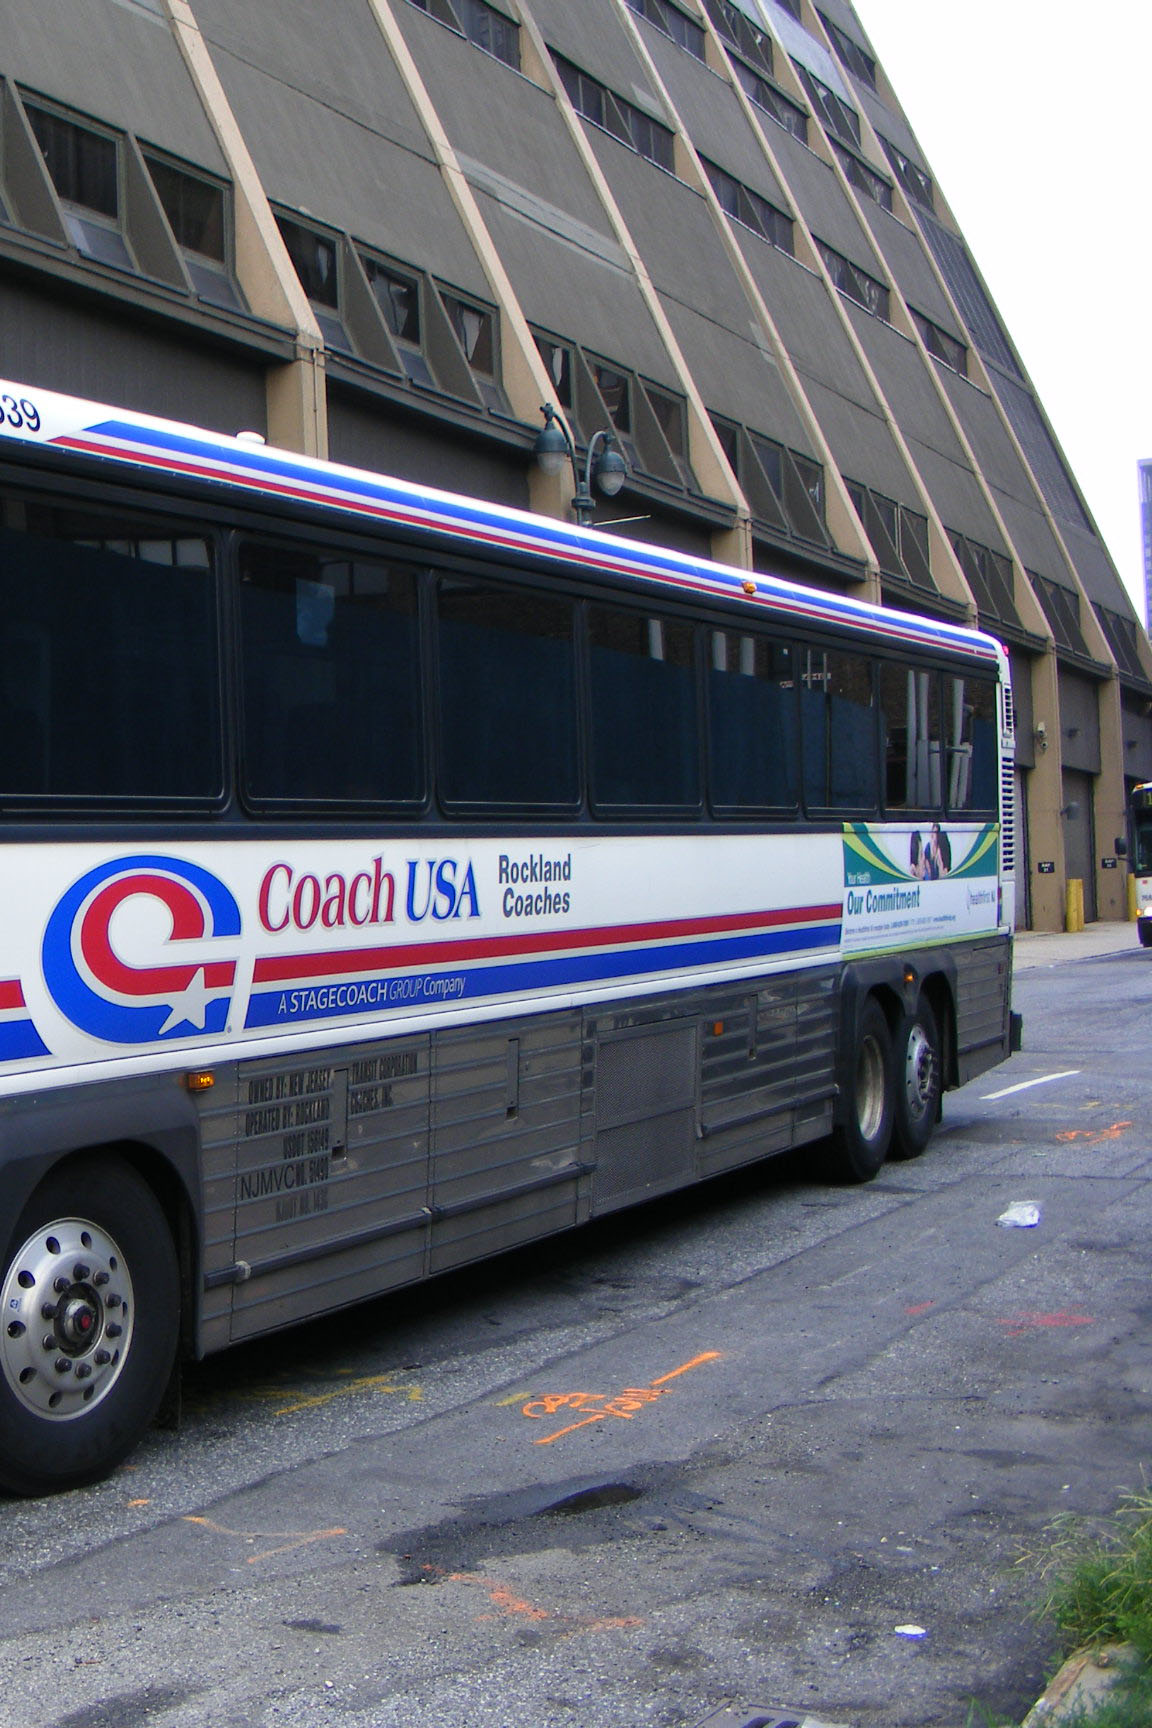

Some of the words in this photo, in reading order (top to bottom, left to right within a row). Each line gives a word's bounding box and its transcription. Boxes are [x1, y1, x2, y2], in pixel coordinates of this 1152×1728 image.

[499, 854, 571, 884] Rockland
[258, 856, 395, 933] Coach
[405, 859, 481, 922] USA
[503, 887, 570, 918] Coaches
[847, 890, 863, 915] Our
[866, 885, 920, 914] Commitment
[278, 994, 288, 1015] A
[290, 983, 387, 1013] STAGECOACH
[389, 979, 423, 1001] GROUP
[423, 977, 465, 998] Company
[241, 1165, 295, 1201] NJMVC
